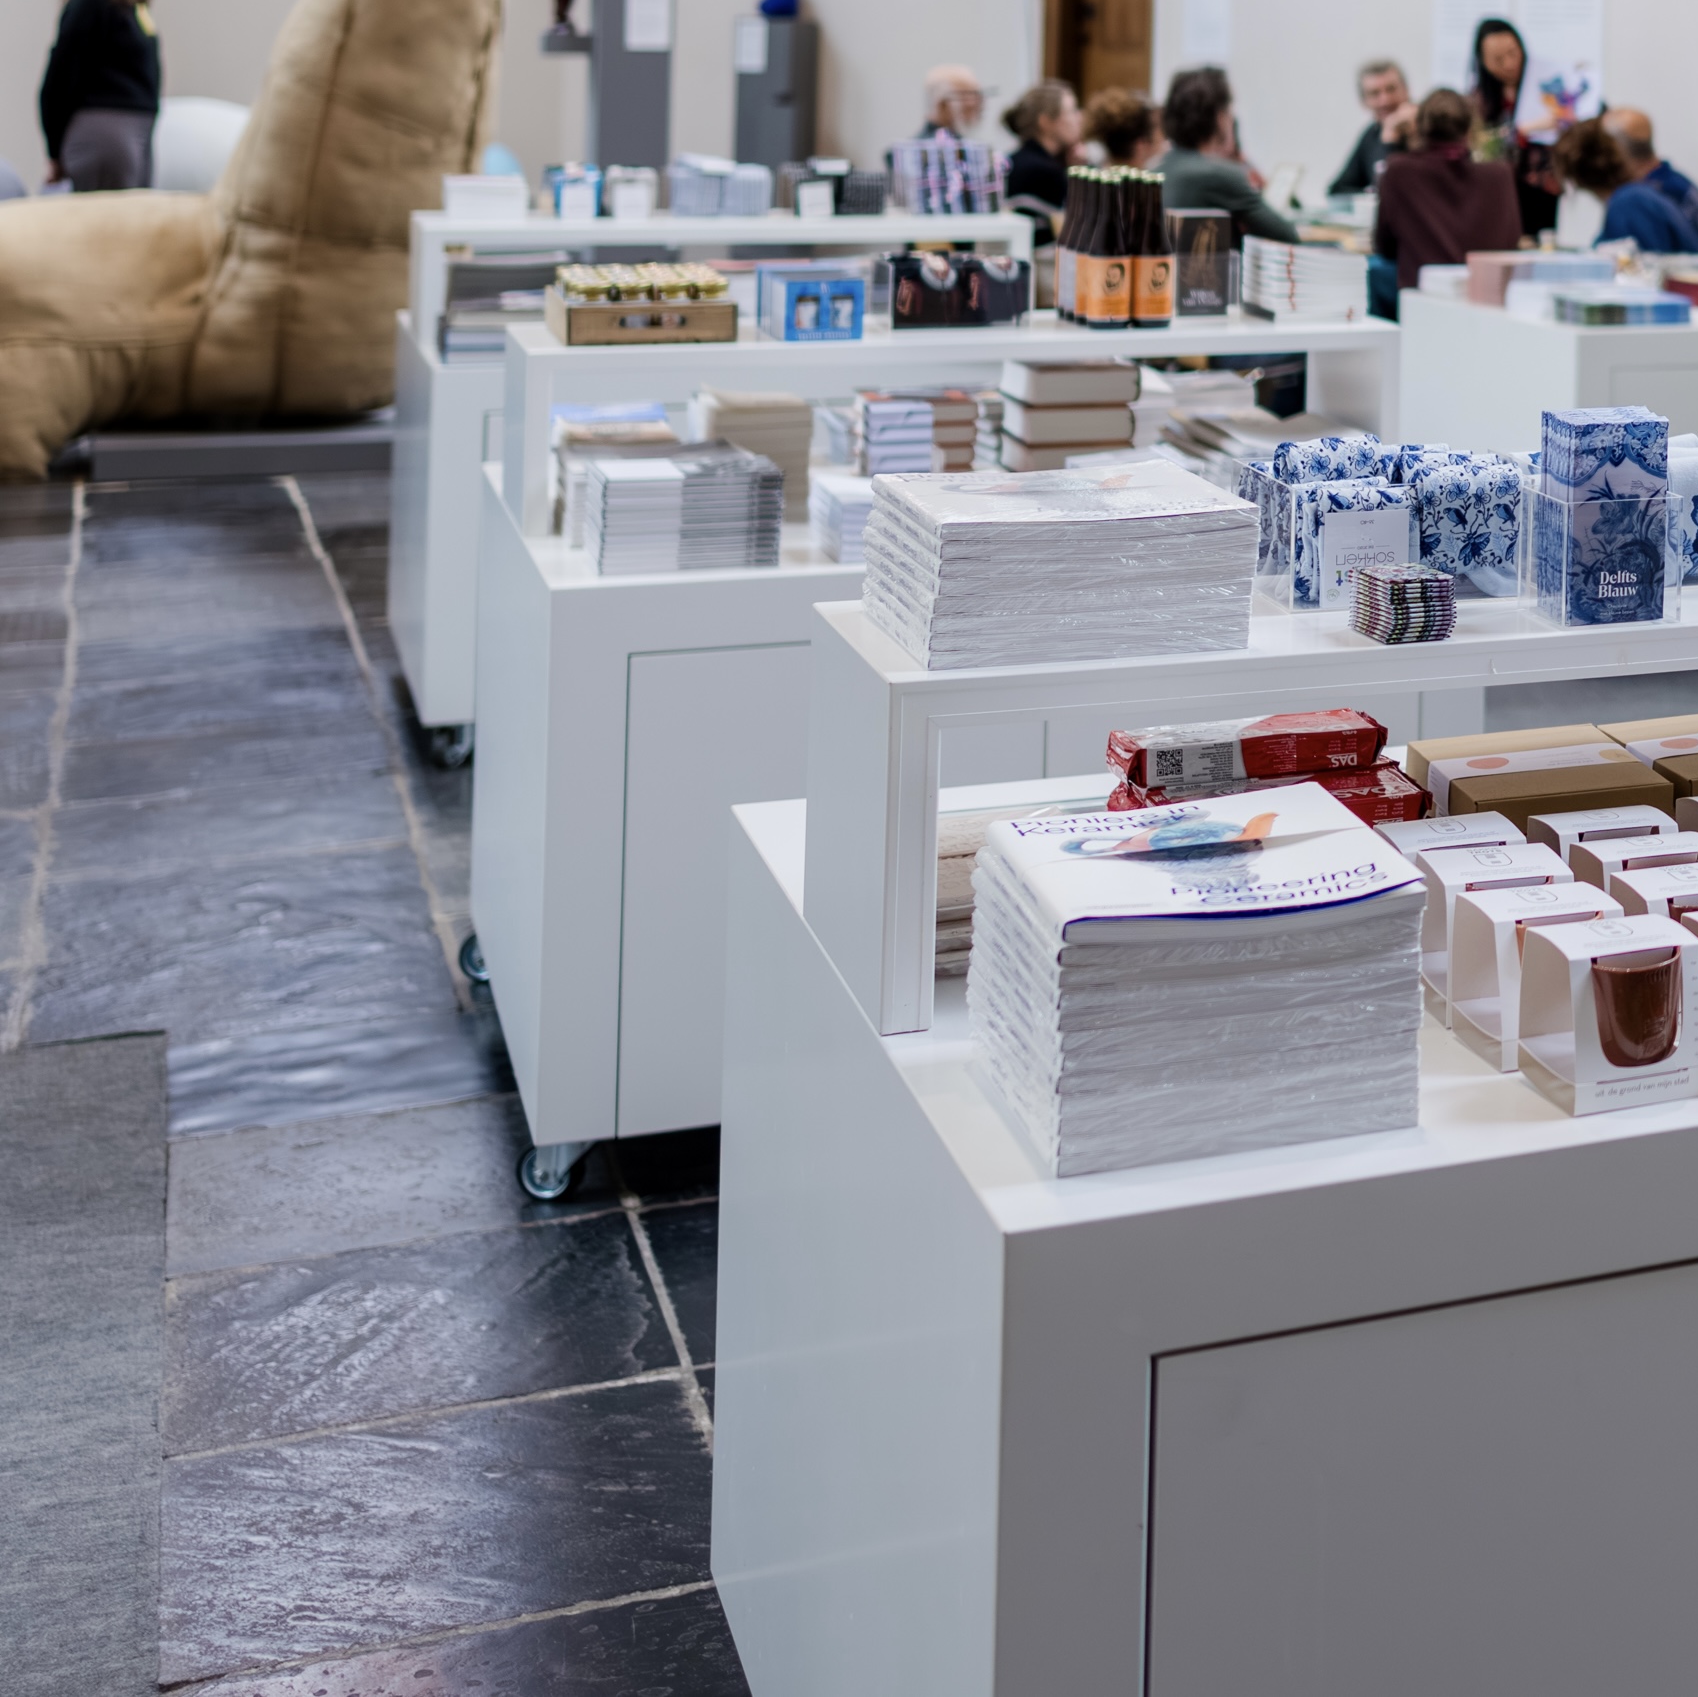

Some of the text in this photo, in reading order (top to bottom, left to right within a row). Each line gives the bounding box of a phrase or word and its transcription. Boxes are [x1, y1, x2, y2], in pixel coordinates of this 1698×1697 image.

[1336, 551, 1395, 566] sokken
[1600, 570, 1637, 584] Delfts
[1599, 584, 1638, 598] Blauw
[1330, 753, 1357, 768] DAS
[1011, 805, 1199, 829] Pioniers in
[1017, 814, 1189, 837] Keramiek
[1172, 862, 1377, 895] Pioneering
[1202, 872, 1388, 903] Ceramics
